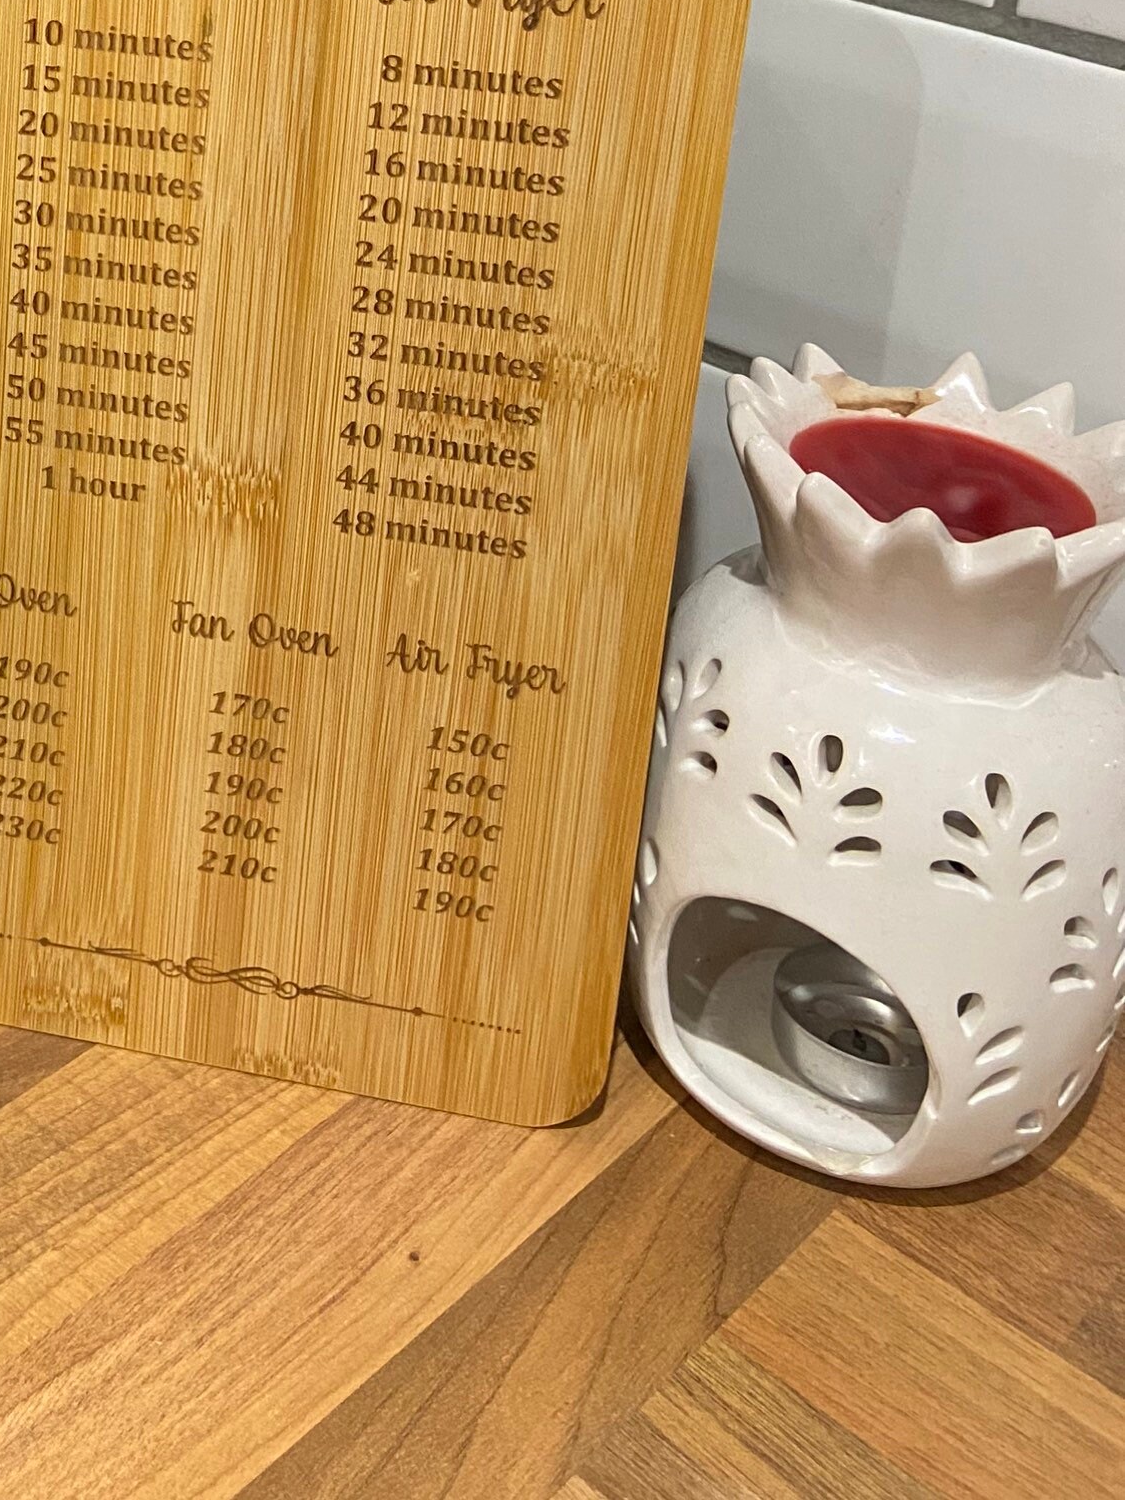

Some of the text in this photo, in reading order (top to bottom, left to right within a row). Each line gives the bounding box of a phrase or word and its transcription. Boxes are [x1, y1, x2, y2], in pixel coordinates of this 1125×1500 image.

[24, 18, 213, 63] 10 minutes
[22, 64, 211, 109] 15 minutes
[382, 55, 563, 99] 8 minutes
[18, 110, 206, 155] 20 minutes
[368, 102, 570, 148] 12 minutes
[16, 154, 203, 201] 25 minutes
[365, 148, 565, 196] 16 minutes
[14, 200, 201, 246] 30 minutes
[359, 194, 560, 243] 20 minutes
[12, 244, 197, 291] 35 minutes
[355, 241, 555, 290] 24 minutes
[10, 289, 195, 335] 40 minutes
[352, 286, 551, 335] 28 minutes
[8, 332, 192, 379] 45 minutes
[348, 332, 547, 381] 32 minutes
[7, 374, 189, 423] 50 minutes
[344, 376, 541, 426] 36 minutes
[5, 416, 186, 466] 55 minutes
[340, 421, 537, 471] 40 minutes
[42, 466, 146, 502] 1 hour
[336, 465, 532, 515] 44 minutes
[332, 509, 527, 559] 48 minutes
[172, 600, 339, 657] Fan Oven
[386, 633, 566, 699] Air Fryer
[209, 691, 290, 724] 170c
[207, 731, 287, 764] 180c
[426, 726, 510, 760] 150c
[204, 771, 284, 804] 190c
[423, 768, 506, 801] 160c
[200, 810, 281, 843] 200c
[419, 808, 503, 842] 170c
[197, 850, 278, 883] 210c
[416, 848, 499, 882] 180c
[412, 888, 494, 923] 190c
